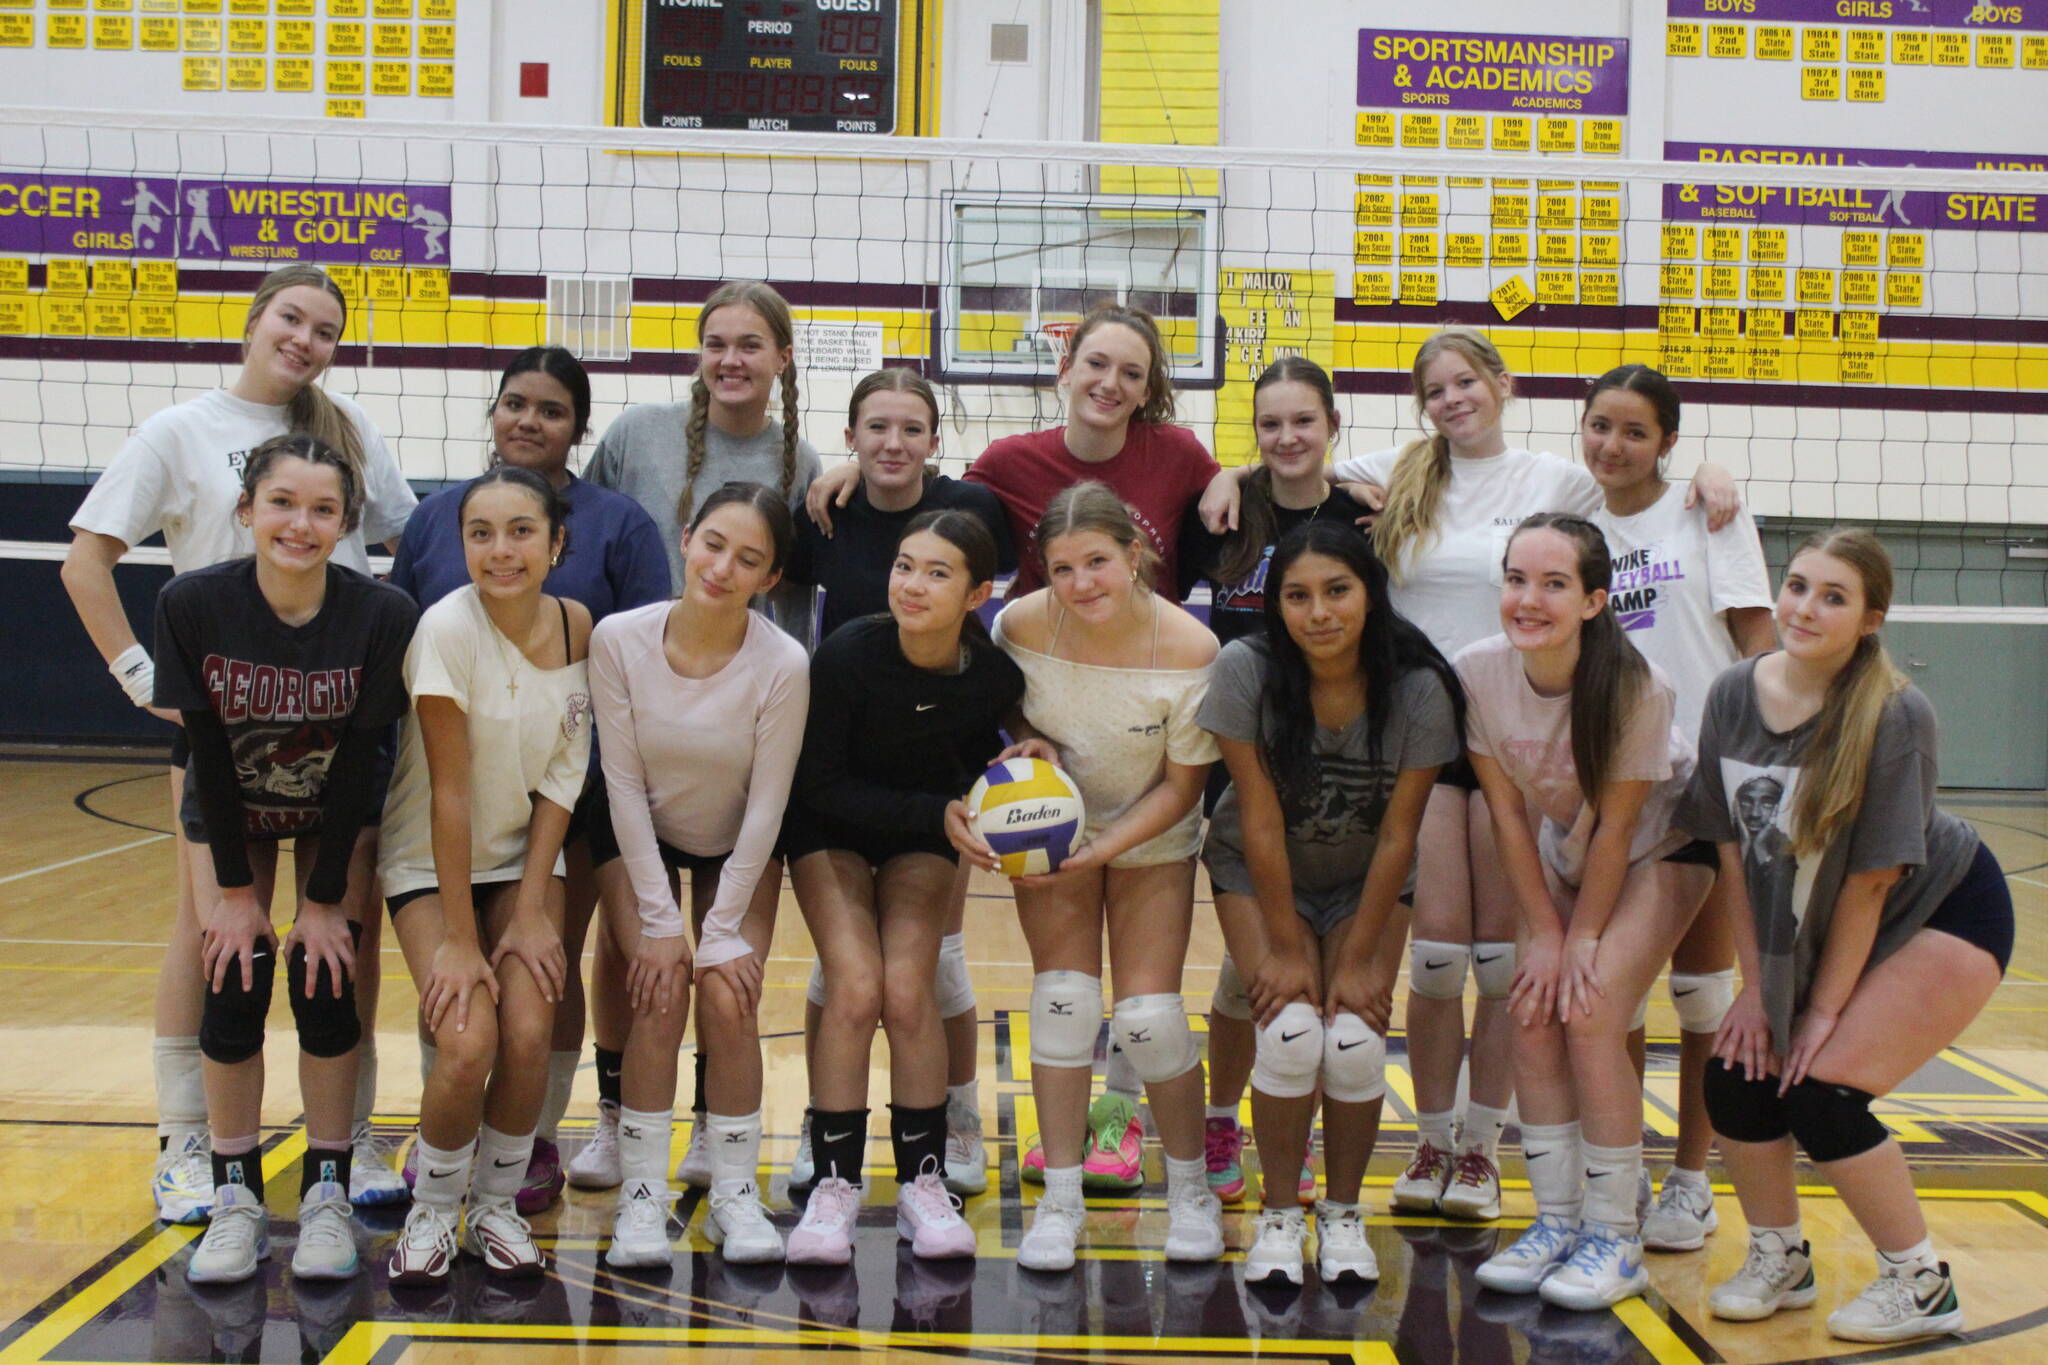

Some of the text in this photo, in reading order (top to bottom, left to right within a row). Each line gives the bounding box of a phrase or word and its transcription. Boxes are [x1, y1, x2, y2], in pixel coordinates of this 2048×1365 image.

[816, 0, 881, 12] GUEST
[1705, 0, 1756, 13] BOYS
[1837, 1, 1893, 18] GIRLS
[1971, 6, 2023, 23] BOYS
[748, 21, 792, 34] PERIOD
[1675, 35, 1692, 43] 3rd
[1719, 36, 1737, 44] 2nd
[1765, 39, 1785, 47] State
[1815, 40, 1830, 48] 5th
[1859, 42, 1874, 50] 4th
[1904, 44, 1920, 52] 2nd
[1373, 36, 1614, 67] SPORTSMANSHIP
[1670, 45, 1696, 53] State
[1715, 46, 1741, 55] State
[1759, 49, 1790, 58] Qualifier
[1809, 50, 1835, 59] State
[1854, 52, 1879, 60] State
[1900, 53, 1924, 62] State
[1938, 54, 1965, 63] State
[664, 55, 701, 67] FOULS
[750, 57, 792, 69] PLAYER
[840, 59, 878, 71] FOULS
[1983, 56, 2008, 65] State
[1393, 65, 1593, 94] & ACADEMICS
[1814, 79, 1829, 87] 3rd
[1809, 88, 1834, 97] State
[1854, 90, 1880, 99] State
[1402, 93, 1450, 105] SPORTS
[1512, 97, 1582, 110] ACADEMICS
[662, 116, 702, 128] POINTS
[1366, 115, 1386, 123] 1997
[1411, 116, 1432, 124] 2000
[749, 119, 789, 131] MATCH
[837, 120, 876, 132] POINTS
[1548, 121, 1567, 129] 2000
[1593, 122, 1612, 130] 2000
[1365, 195, 1384, 203] 2002
[1679, 184, 1872, 208] & SOFTBALL
[0, 184, 101, 218] CCER
[228, 189, 408, 218] WRESTLING
[1701, 207, 1756, 218] BASEBALL
[1946, 194, 2036, 222] STATE
[1590, 209, 1610, 217] Drama
[1829, 211, 1884, 223] SOFTBALL
[258, 218, 377, 244] & GOLF
[1685, 228, 1694, 236] 1A
[1775, 231, 1784, 239] 1A
[73, 232, 133, 249] GIRLS
[1410, 235, 1429, 243] 2004
[1455, 236, 1475, 244] 2005
[1500, 236, 1520, 244] 2005
[1670, 238, 1685, 246] 2nd
[1869, 235, 1878, 243] 1A
[1716, 240, 1729, 248] 3rd
[1852, 244, 1871, 252] State
[229, 246, 298, 258] WRESTLING
[1410, 245, 1429, 253] Track
[1498, 245, 1521, 253] Baseball
[1592, 247, 1607, 256] Boys
[1667, 248, 1688, 256] State
[1712, 249, 1733, 258] State
[371, 249, 402, 260] GOLF
[1752, 250, 1784, 259] Qualifier
[1847, 254, 1877, 262] Qualifier
[1227, 272, 1234, 288] 1
[376, 289, 399, 298] State
[419, 290, 441, 298] State
[1285, 310, 1300, 327] AN
[1226, 328, 1265, 344] 4 KIRK
[1006, 804, 1061, 824] Baden
